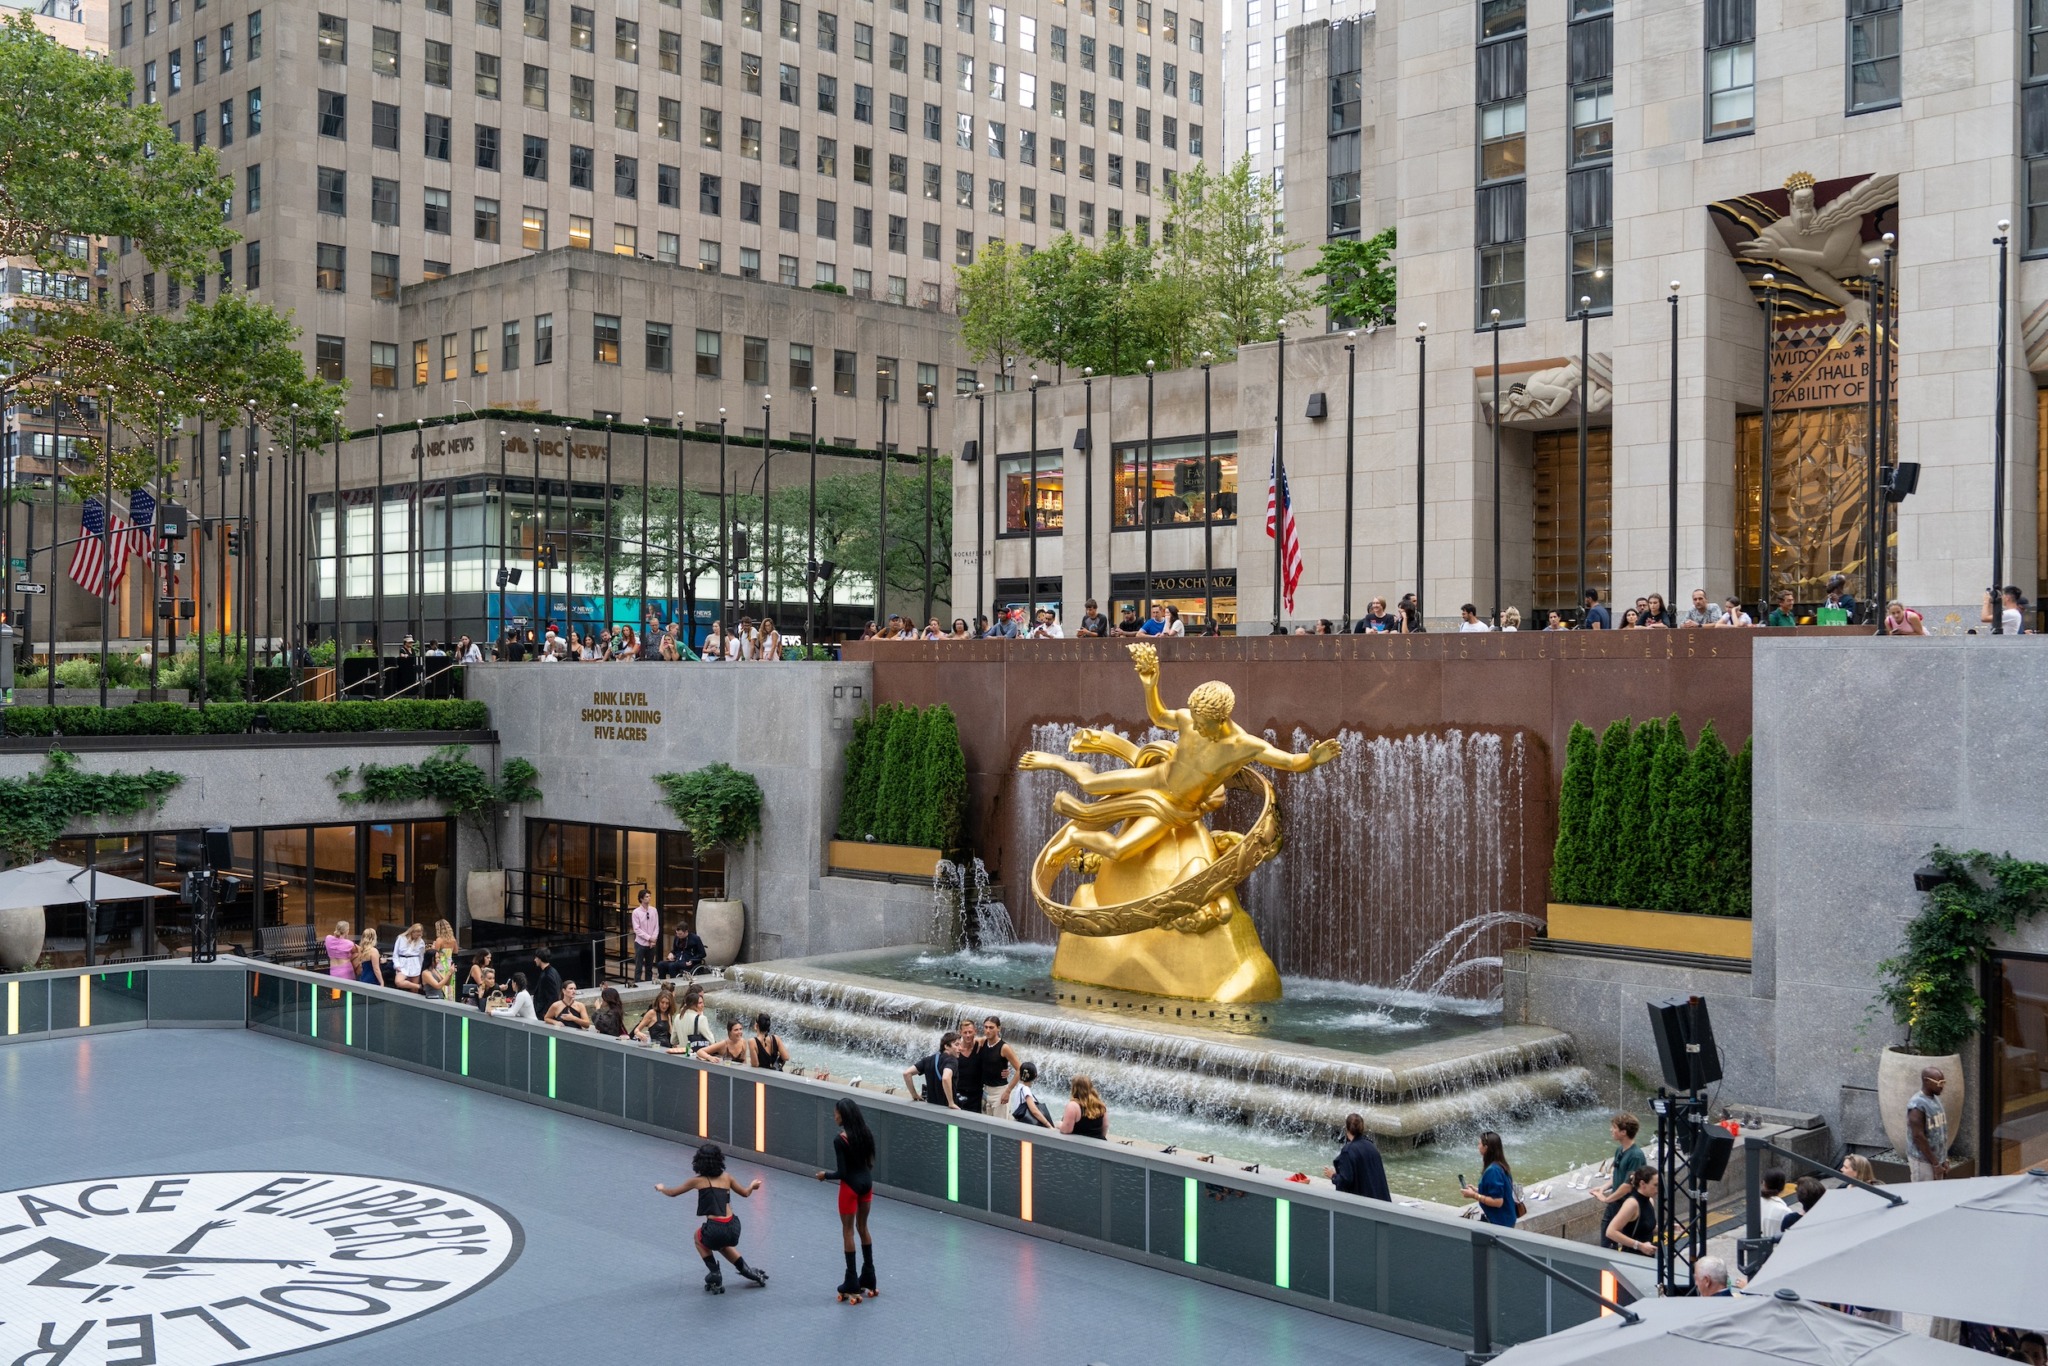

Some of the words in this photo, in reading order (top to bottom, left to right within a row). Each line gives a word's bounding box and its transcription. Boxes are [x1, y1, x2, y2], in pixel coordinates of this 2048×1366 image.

[1772, 349, 1832, 366] WISDO
[1834, 351, 1850, 360] AND
[1816, 364, 1857, 381] SHALL
[1772, 384, 1841, 403] STABILITY
[1843, 382, 1865, 397] OF
[427, 440, 446, 457] NBC
[448, 437, 475, 455] NEWS
[536, 440, 563, 457] NBC
[781, 635, 801, 646] EWS
[1318, 638, 1358, 648] ART
[1540, 635, 1587, 645] THE
[1623, 634, 1695, 644] FIRE
[1175, 651, 1274, 661] MORTALS
[1335, 649, 1412, 660] MEANS
[1443, 649, 1468, 660] TO
[1645, 646, 1718, 658] ENDS
[593, 692, 617, 705] RINK
[619, 692, 648, 706] LEVEL
[581, 708, 613, 722] SHOPS
[615, 709, 622, 723] &
[624, 710, 661, 724] DINING
[594, 726, 614, 739] FIVE
[616, 727, 647, 741] ACRES
[0, 1178, 191, 1235] ACE
